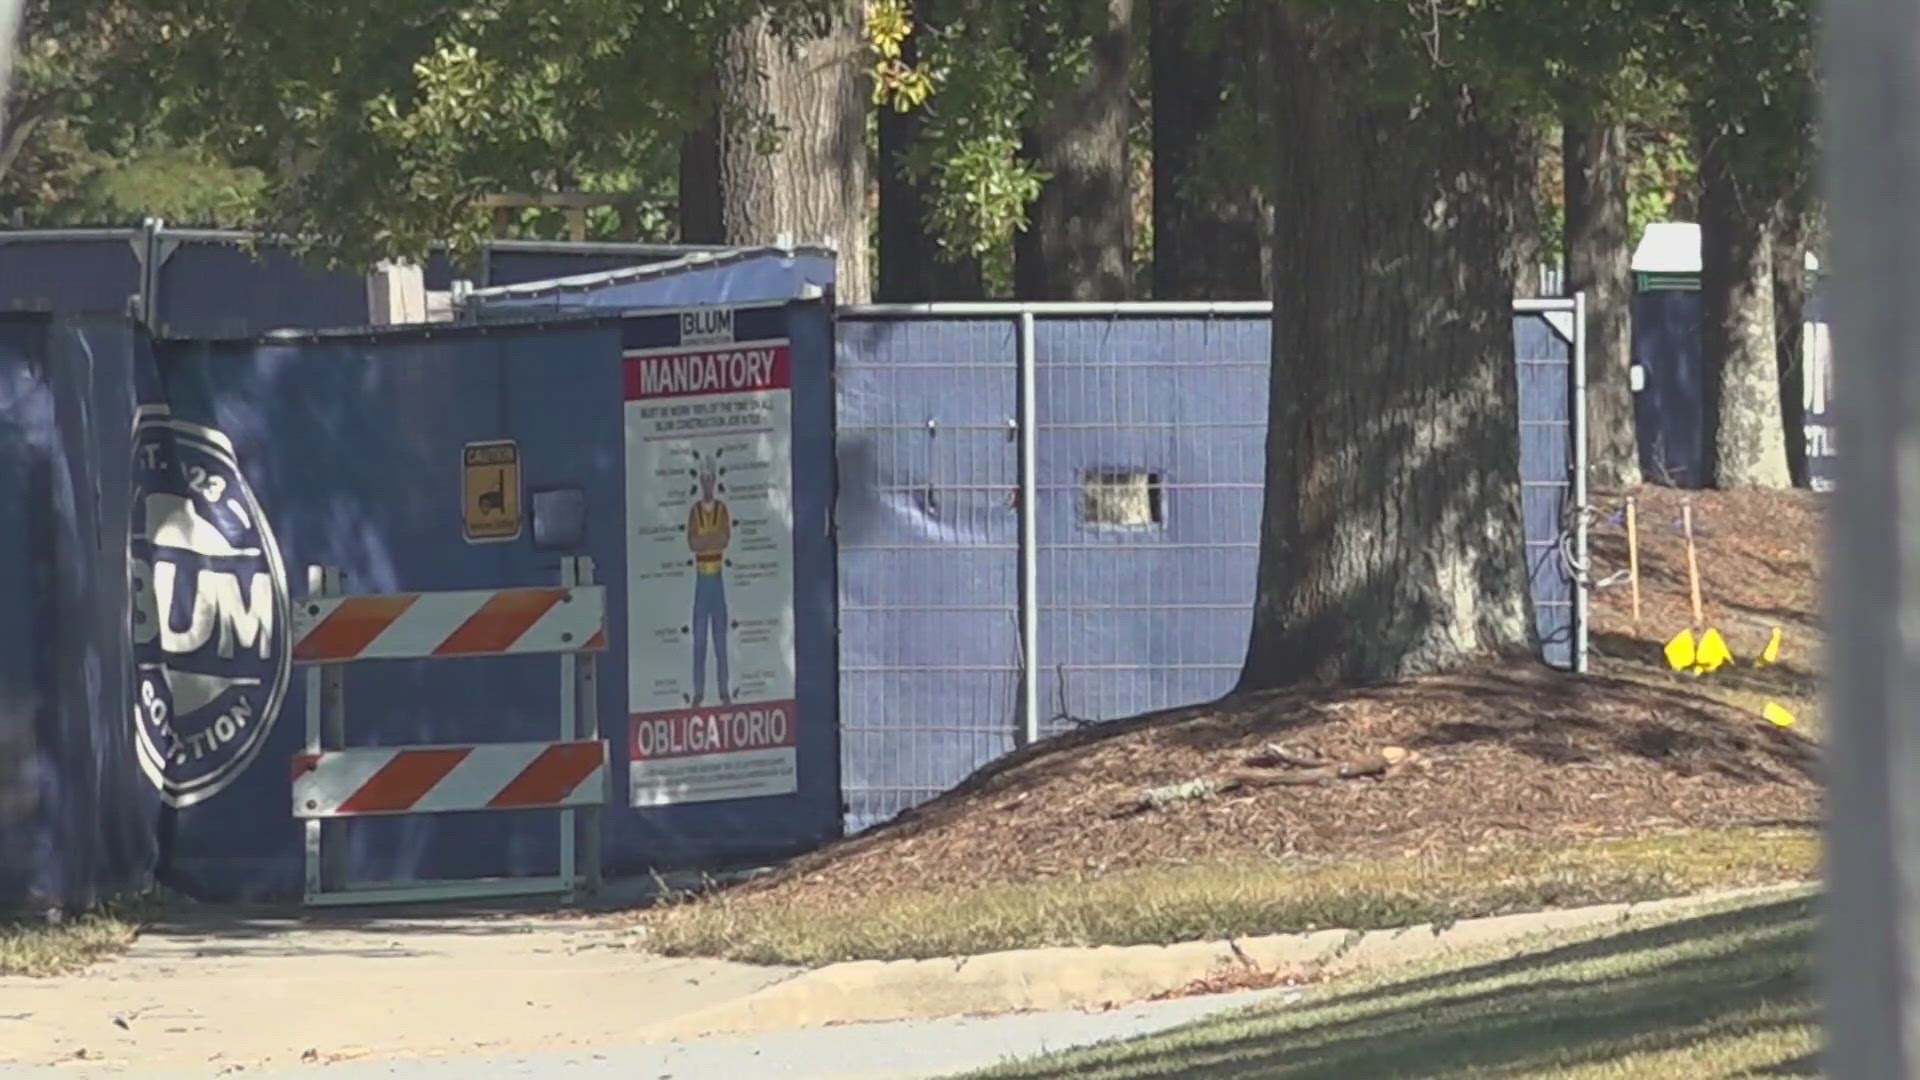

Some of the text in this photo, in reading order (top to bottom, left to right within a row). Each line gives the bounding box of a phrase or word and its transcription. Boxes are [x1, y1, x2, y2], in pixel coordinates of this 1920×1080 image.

[683, 309, 731, 335] BLUM
[639, 350, 775, 394] MANDATORY
[638, 708, 787, 756] OBLIGATORIO
